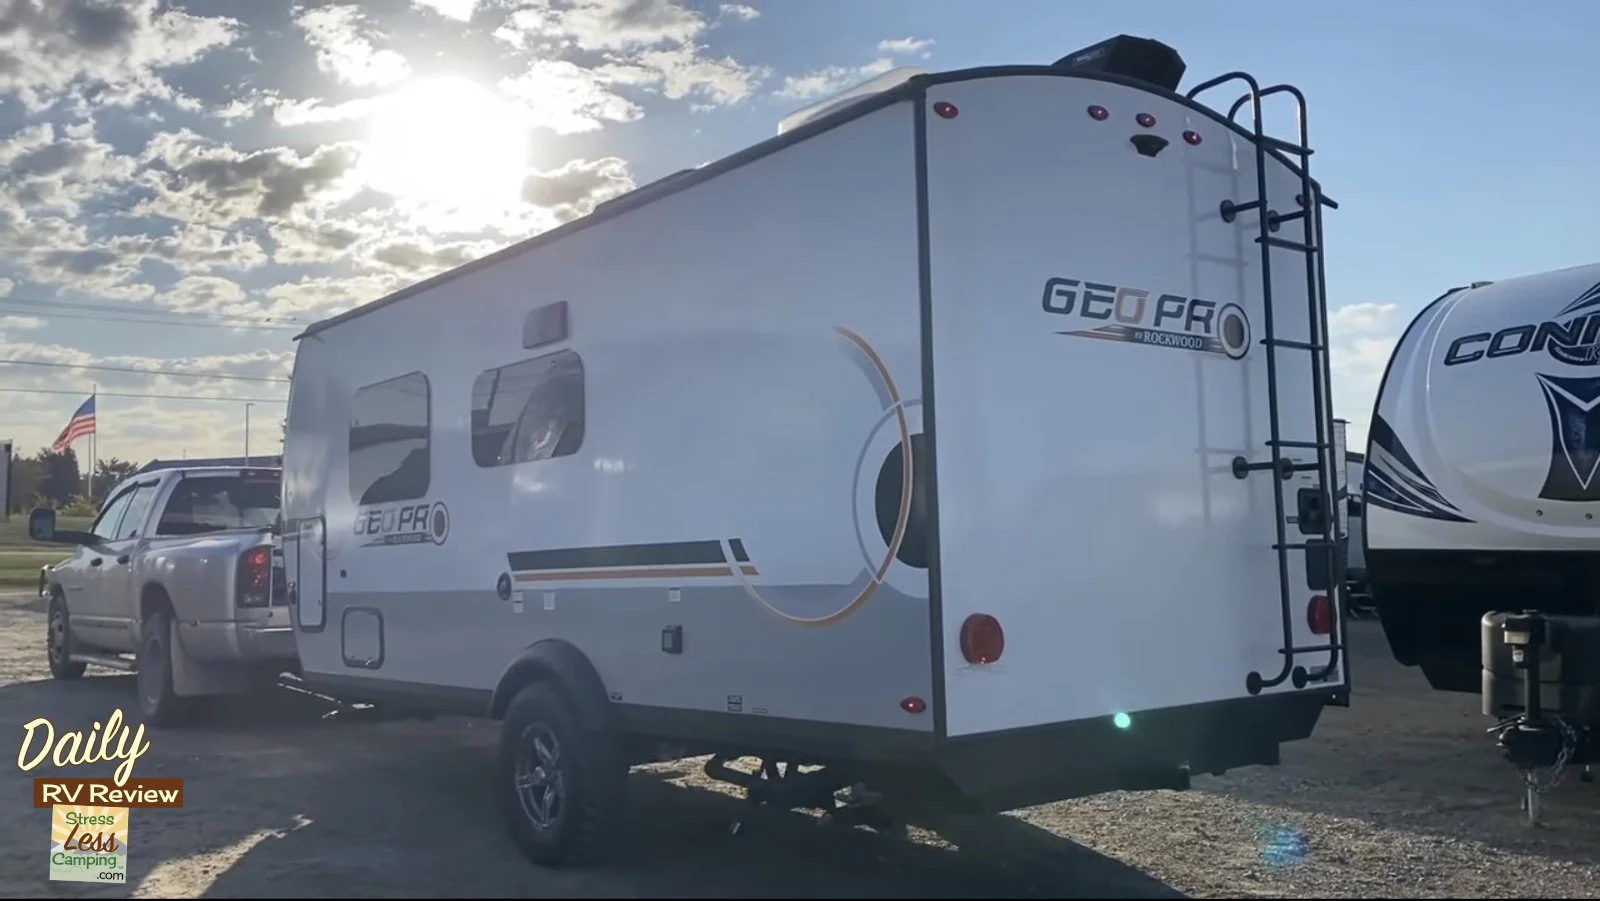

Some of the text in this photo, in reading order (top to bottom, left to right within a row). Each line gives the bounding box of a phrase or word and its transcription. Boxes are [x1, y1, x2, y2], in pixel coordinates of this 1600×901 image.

[1042, 277, 1250, 360] GEO PRO
[1144, 331, 1203, 349] ROCKWOOD
